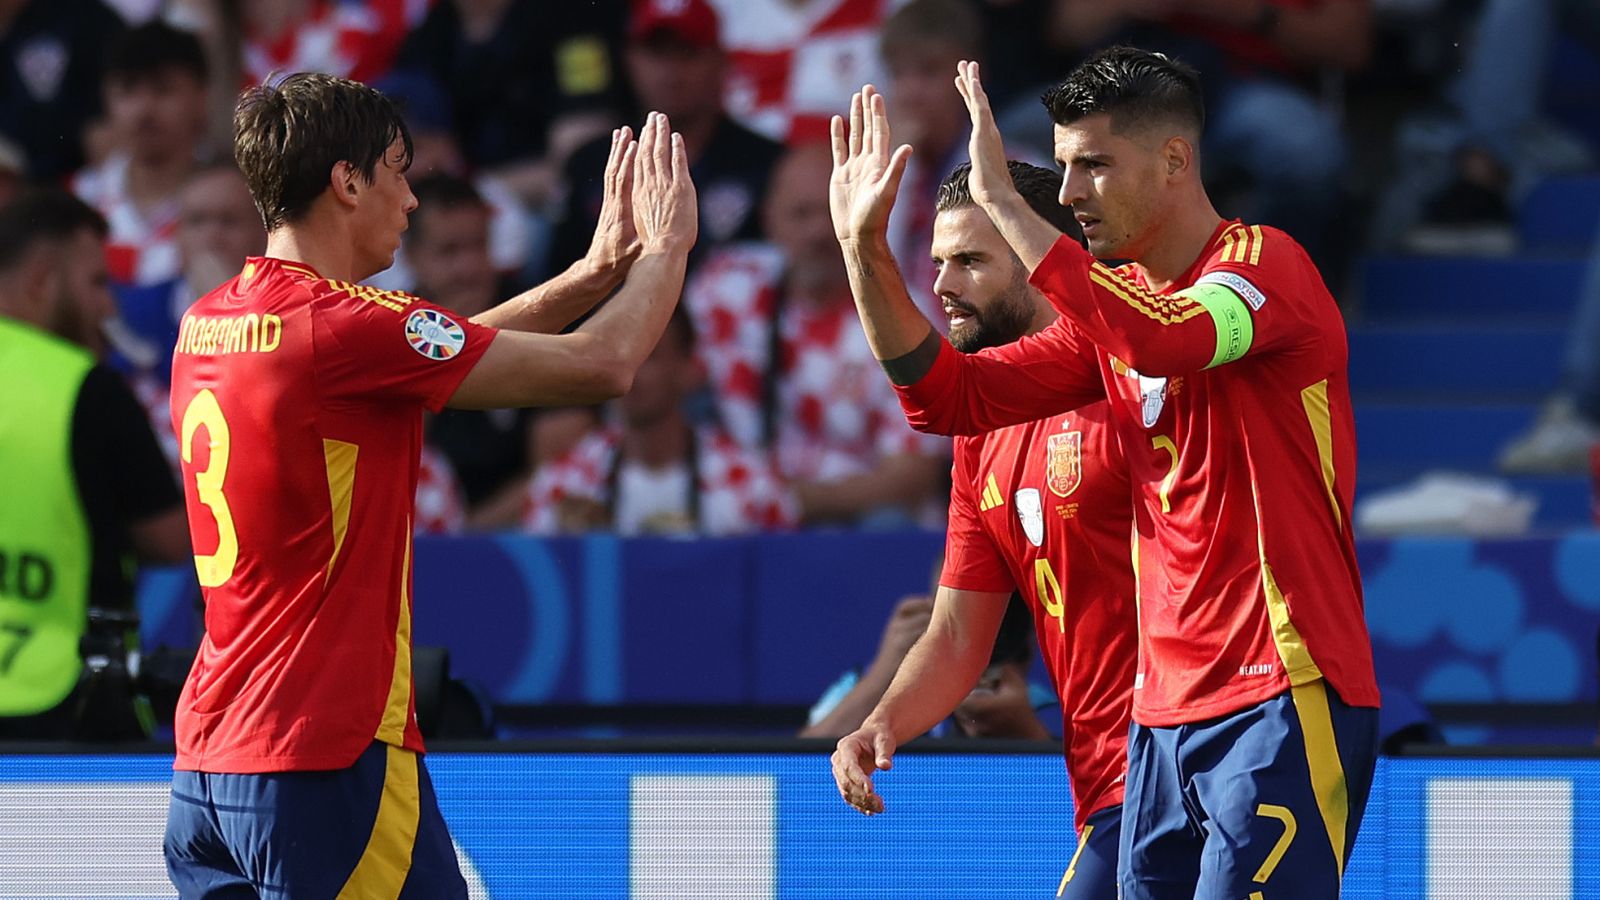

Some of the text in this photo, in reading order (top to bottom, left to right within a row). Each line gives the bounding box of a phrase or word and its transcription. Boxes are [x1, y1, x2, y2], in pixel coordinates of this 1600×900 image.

[179, 313, 282, 355] NORMAND
[181, 388, 239, 588] 3
[1152, 434, 1179, 513] 7
[1035, 558, 1065, 633] 4
[1252, 803, 1297, 884] 7
